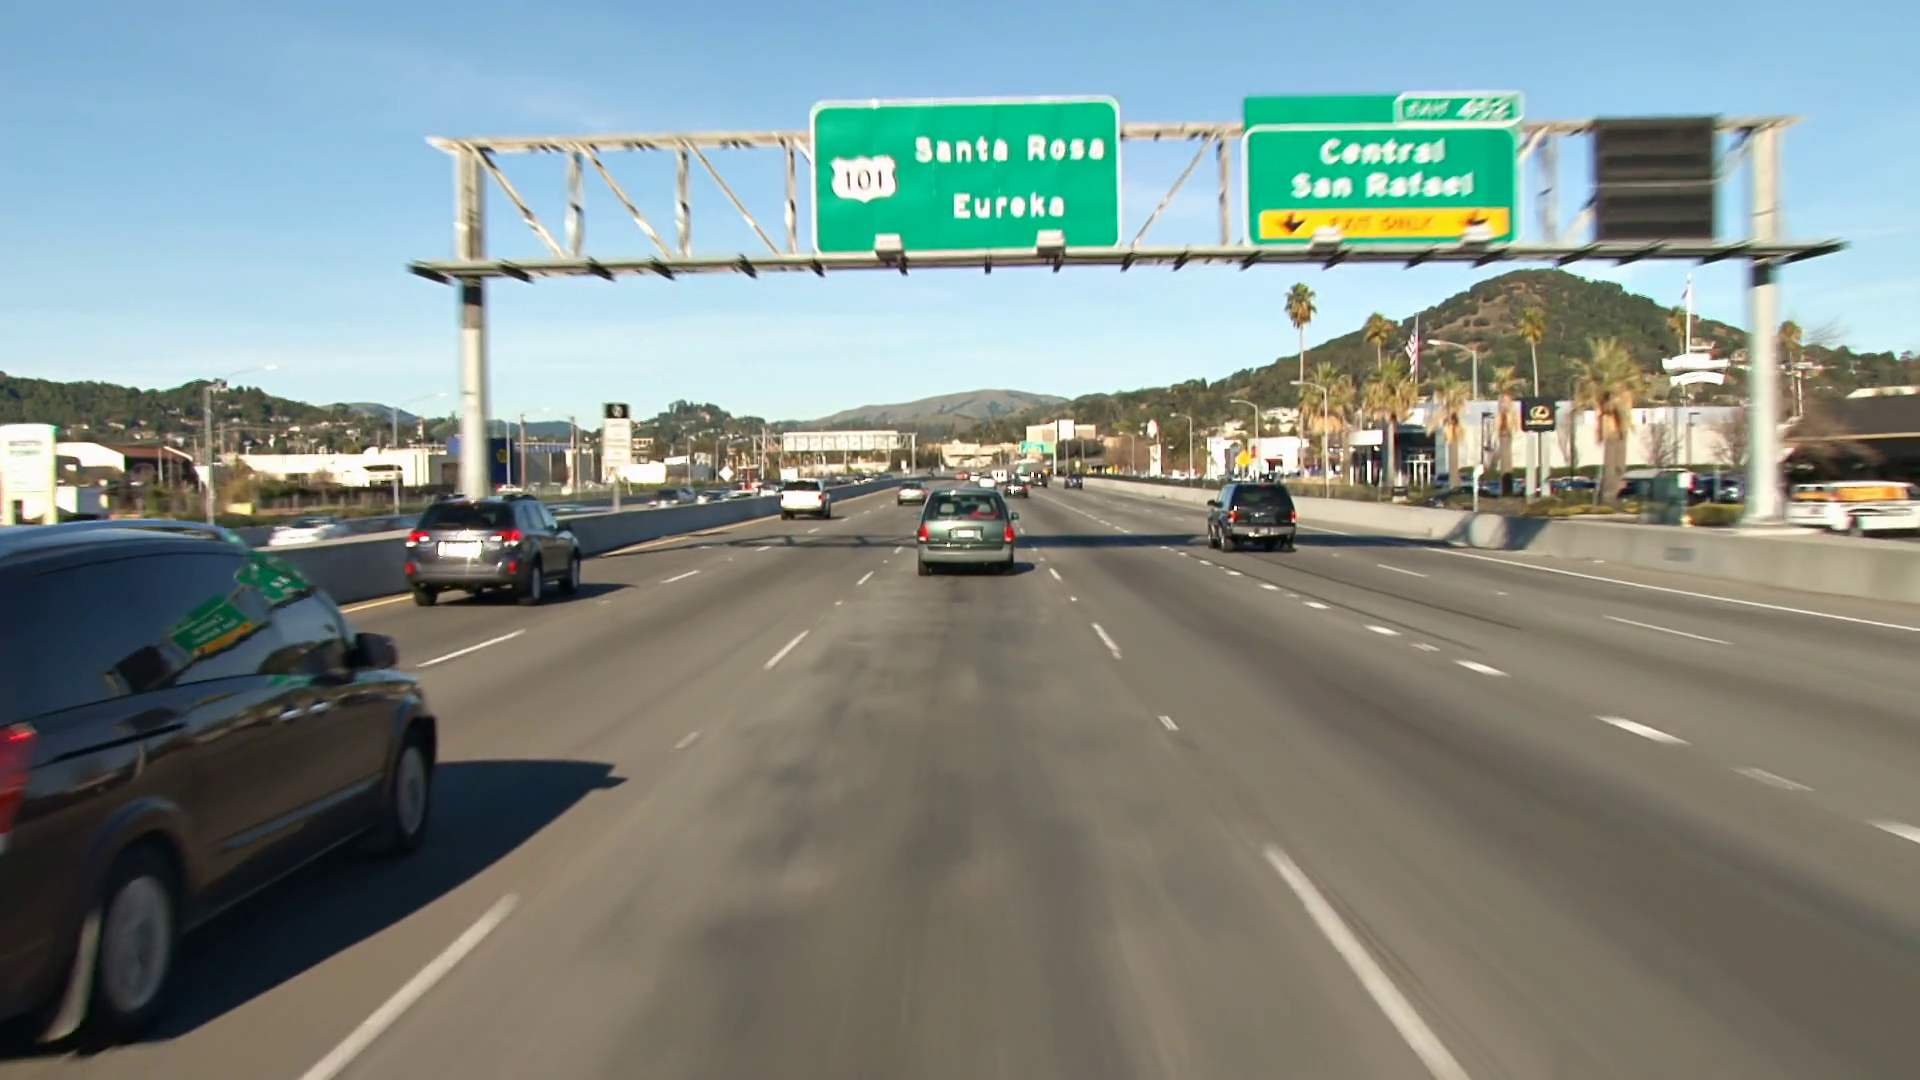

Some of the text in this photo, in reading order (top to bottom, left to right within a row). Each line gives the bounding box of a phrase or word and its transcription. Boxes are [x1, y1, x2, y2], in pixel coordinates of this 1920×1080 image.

[915, 134, 1105, 163] Santa Rosa
[1320, 138, 1446, 165] Central
[845, 169, 883, 190] 101
[1290, 170, 1474, 199] San Rafael
[953, 192, 1065, 219] Eureka
